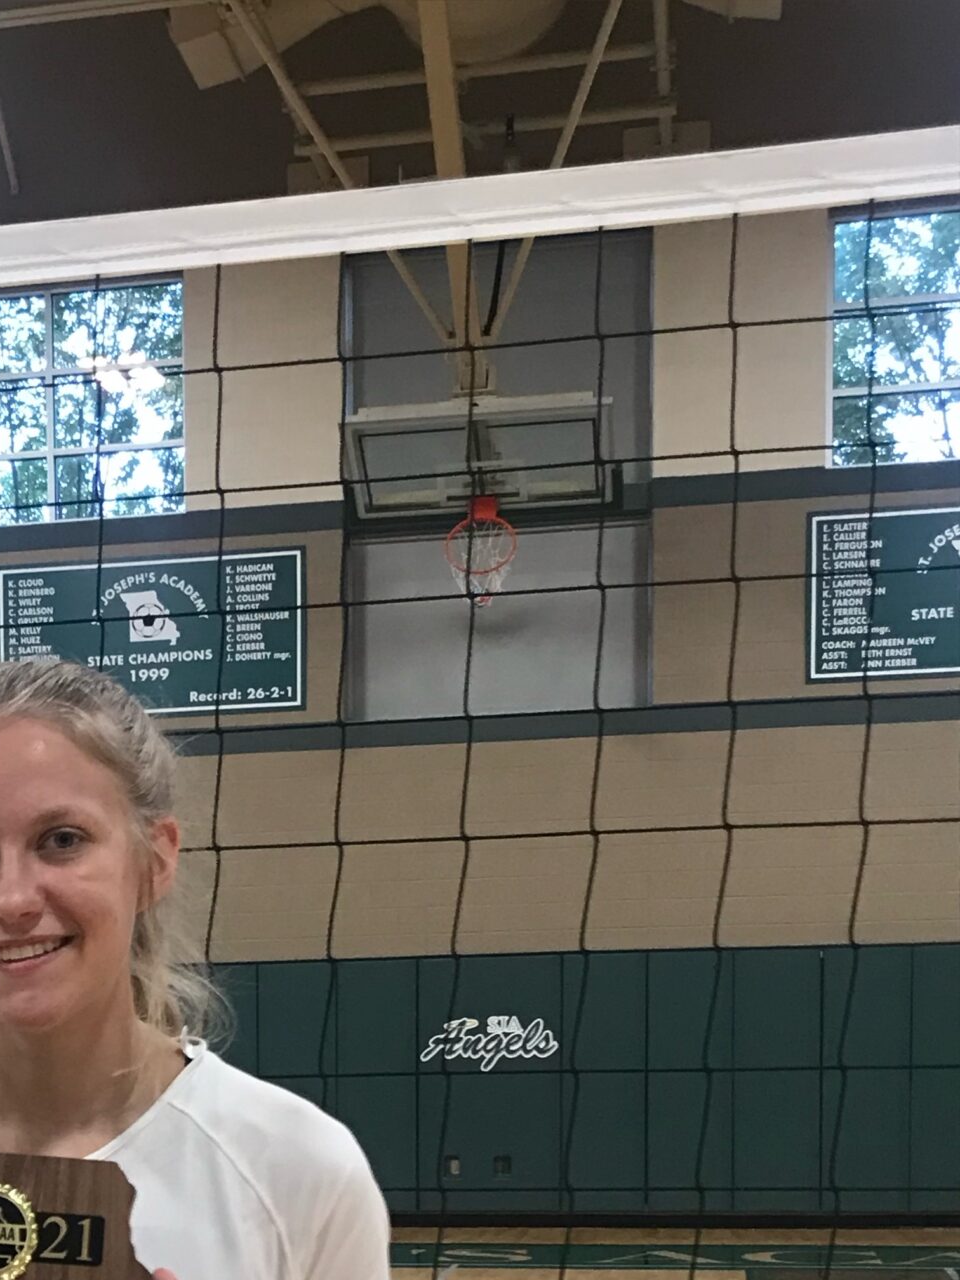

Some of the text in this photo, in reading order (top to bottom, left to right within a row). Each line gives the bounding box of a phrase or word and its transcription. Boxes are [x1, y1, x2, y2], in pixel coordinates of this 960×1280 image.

[833, 522, 869, 531] SLATTER
[833, 551, 866, 560] LARSEN
[236, 563, 273, 573] HADICAN
[834, 559, 880, 569] SCHNARE
[833, 579, 872, 588] LAMPING
[101, 572, 155, 606] JOSEPH'S
[911, 607, 954, 620] STATE
[832, 626, 868, 635] SKAGGS
[822, 641, 856, 649] COACH:
[885, 648, 912, 656] ERNST
[88, 650, 213, 666] STATE CHAMPIONS
[130, 669, 169, 682] 1999
[247, 687, 292, 699] 26-2-1
[420, 1017, 559, 1072] Angels
[41, 1216, 92, 1261] 21
